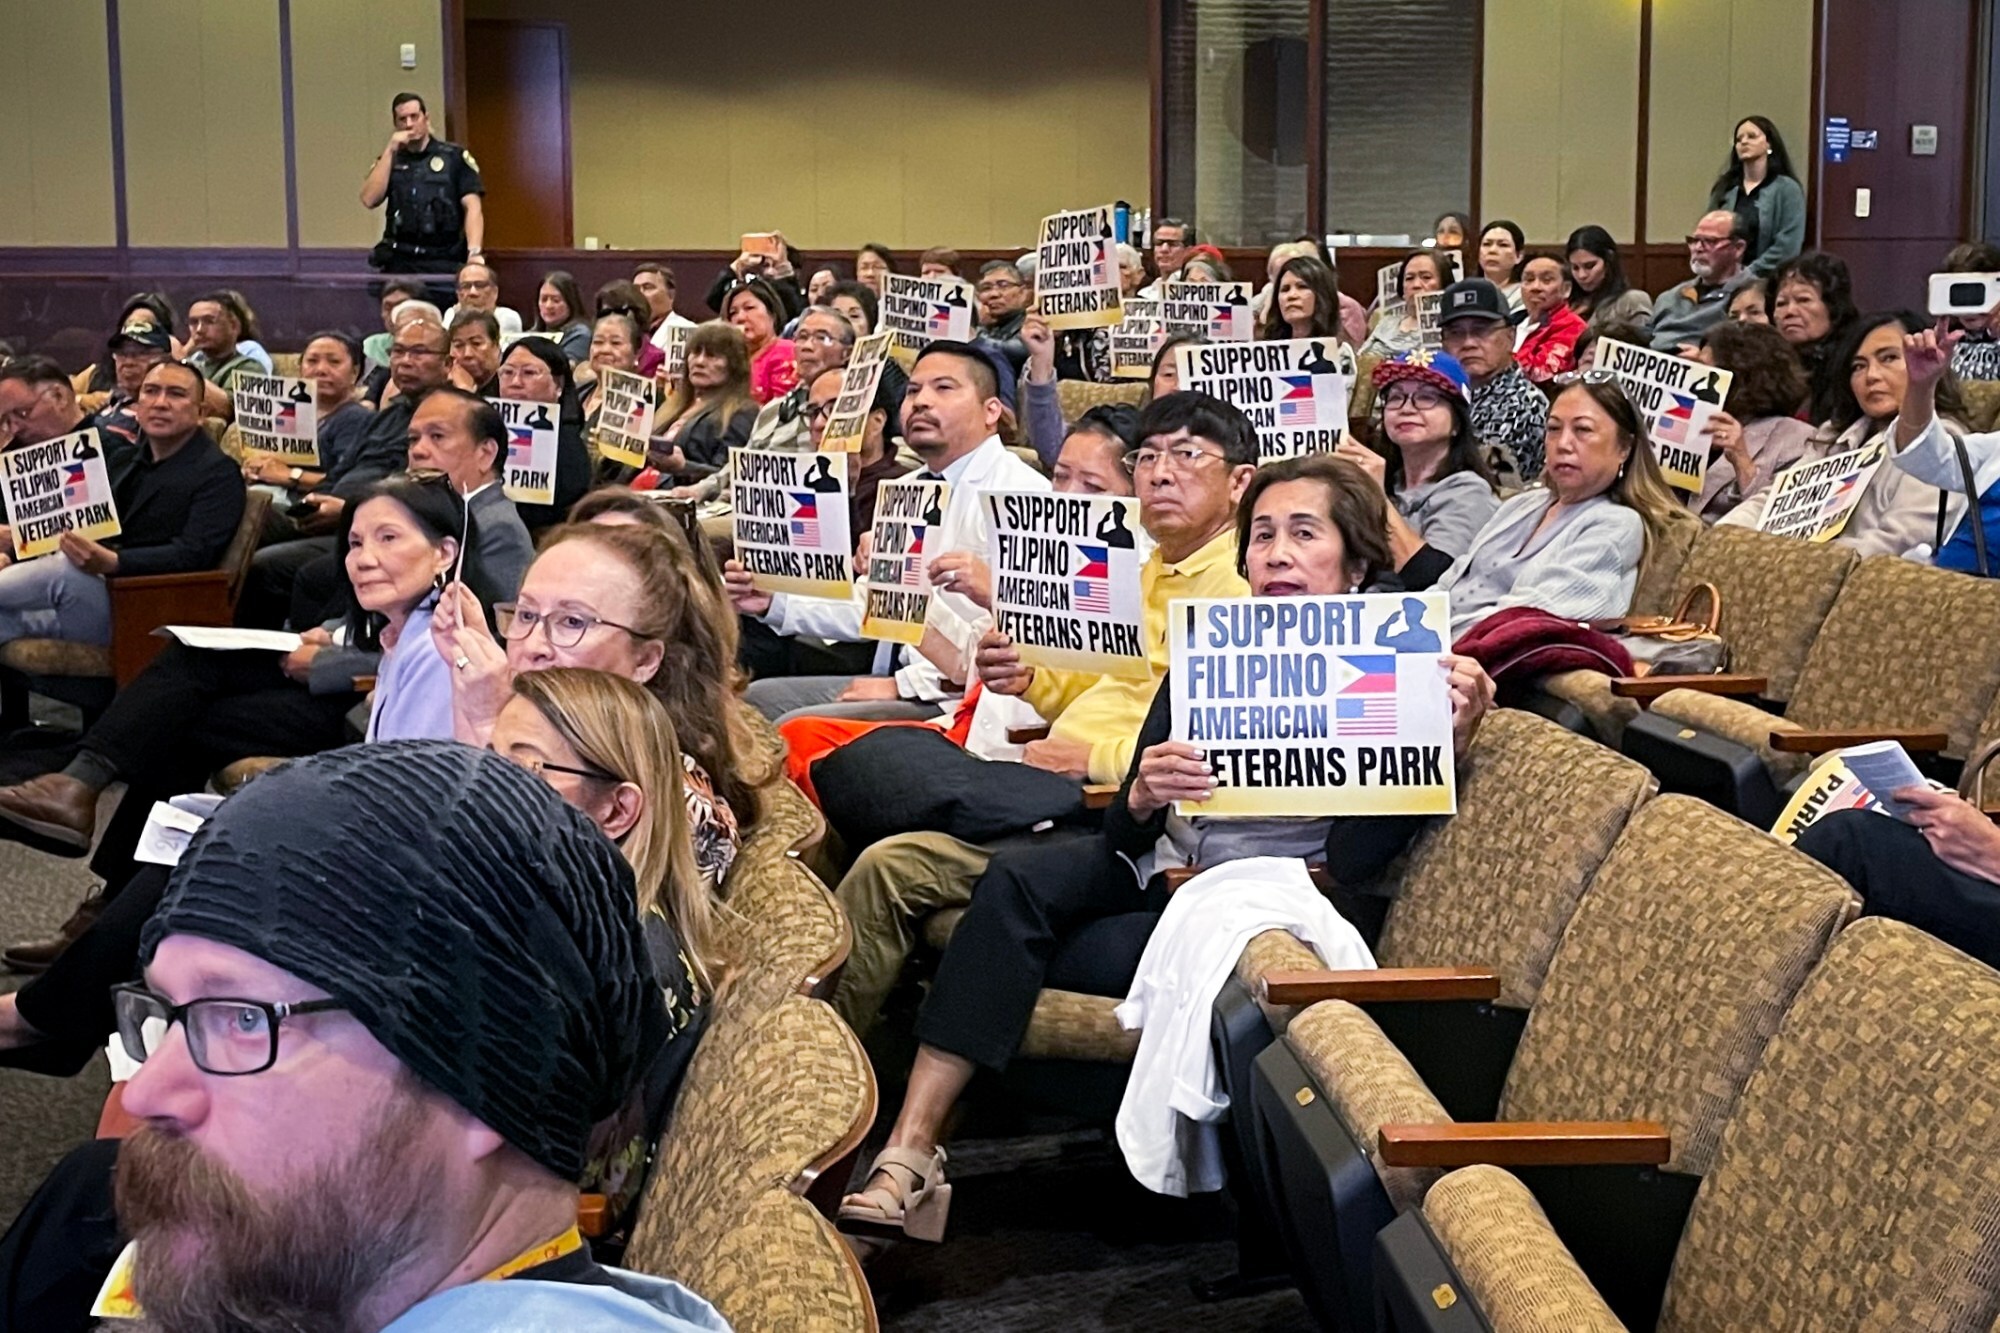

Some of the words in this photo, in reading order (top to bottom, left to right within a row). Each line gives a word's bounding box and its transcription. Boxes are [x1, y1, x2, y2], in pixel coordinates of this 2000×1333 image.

[1047, 212, 1097, 241] SUPPORT
[1040, 241, 1091, 270] FILIPINO
[891, 277, 942, 300] SUPPORT
[1039, 269, 1091, 291] AMERICAN
[1162, 284, 1166, 299] I
[1169, 284, 1221, 302] SUPPORT
[885, 295, 927, 318] FILIPINO
[1164, 303, 1208, 321] FILIPINO
[1187, 351, 1194, 377] I
[1200, 345, 1290, 376] SUPPORT
[1602, 343, 1611, 367] I
[1613, 346, 1691, 389] SUPPORT
[240, 373, 284, 397] SUPPORT
[4, 456, 11, 478] I
[14, 439, 67, 475] SUPPORT
[282, 438, 315, 455] PARK
[1659, 445, 1702, 478] PARK
[10, 468, 60, 502] FILIPINO
[511, 469, 549, 490] PARK
[733, 451, 738, 480] I
[740, 451, 797, 486] SUPPORT
[1778, 474, 1789, 494] I
[1788, 452, 1862, 491] SUPPORT
[15, 492, 64, 522] AMERICAN
[735, 485, 786, 519] FILIPINO
[882, 485, 924, 518] SUPPORT
[990, 495, 1001, 529] I
[1005, 495, 1091, 537] SUPPORT
[1767, 481, 1833, 518] FILIPINO
[19, 511, 74, 544] VETERANS
[75, 501, 114, 528] PARK
[737, 519, 790, 546] AMERICAN
[1761, 504, 1823, 533] AMERICAN
[872, 521, 907, 554] FILIPINO
[804, 553, 847, 581] PARK
[998, 534, 1069, 577] FILIPINO
[997, 576, 1070, 611] AMERICAN
[1088, 620, 1143, 657] PARK
[1186, 605, 1195, 649] I
[1208, 601, 1365, 649] SUPPORT
[1187, 653, 1327, 699] FILIPINO
[1187, 704, 1328, 741] AMERICAN
[1202, 748, 1347, 787] ETERANS
[1358, 746, 1444, 786] PARK
[1786, 773, 1845, 840] PARK
